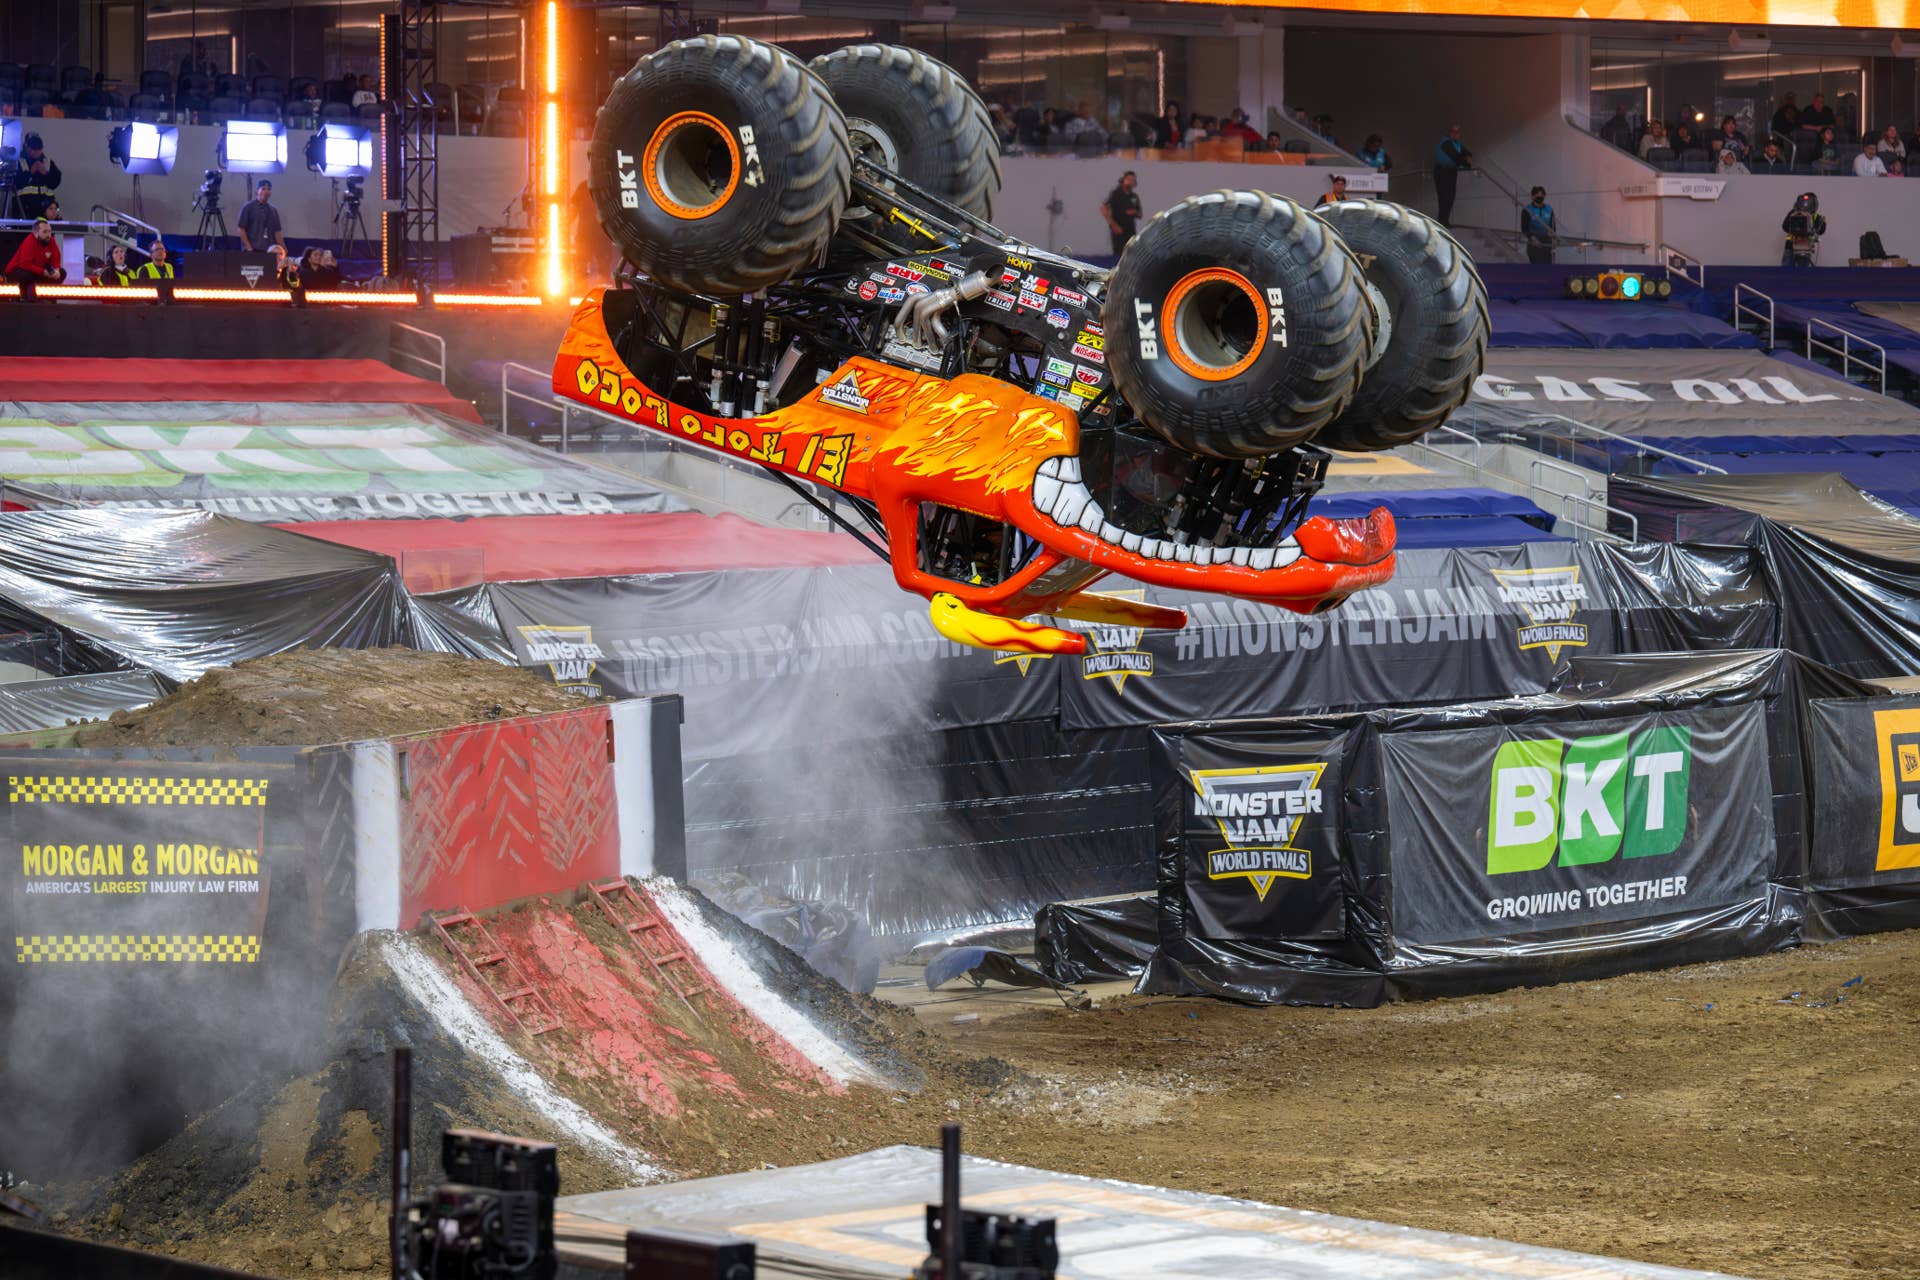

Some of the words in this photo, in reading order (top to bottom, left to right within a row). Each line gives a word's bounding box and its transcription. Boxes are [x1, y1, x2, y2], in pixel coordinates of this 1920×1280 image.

[617, 149, 639, 209] BKT
[887, 265, 923, 281] ARP
[1007, 256, 1032, 271] UNOH
[1267, 287, 1288, 348] BKT
[1134, 298, 1159, 360] BKT
[1074, 345, 1104, 361] SIMPSON
[1077, 370, 1100, 384] JAZ
[822, 387, 870, 407] MONSTER
[836, 383, 859, 395] JAM
[1671, 376, 1842, 404] OIL
[1497, 583, 1589, 603] MONSTER
[1529, 602, 1571, 620] JAM
[1175, 586, 1497, 661] #MONSTERJAM
[1095, 628, 1137, 648] JAM
[1521, 628, 1553, 644] WORLD
[1554, 626, 1585, 641] FINALS
[526, 641, 605, 661] MONSTER
[556, 660, 592, 680] JAM
[1086, 656, 1119, 673] WORLD
[1120, 655, 1151, 671] FINALS
[1194, 789, 1323, 817] MONSTER
[1495, 751, 1684, 848] BKT
[1227, 817, 1289, 842] JAM
[22, 845, 124, 877] MORGAN
[132, 844, 149, 876] &
[157, 844, 259, 876] MORGAN
[1212, 851, 1260, 873] WORLD
[1263, 851, 1307, 872] FINALS
[26, 881, 91, 894] AMERICA'S
[94, 881, 147, 894] LARGEST
[150, 880, 195, 894] INJURY
[199, 880, 225, 893] LAW
[228, 880, 259, 893] FIRM
[1487, 889, 1582, 920] GROWING
[1586, 876, 1688, 908] TOGETHER
